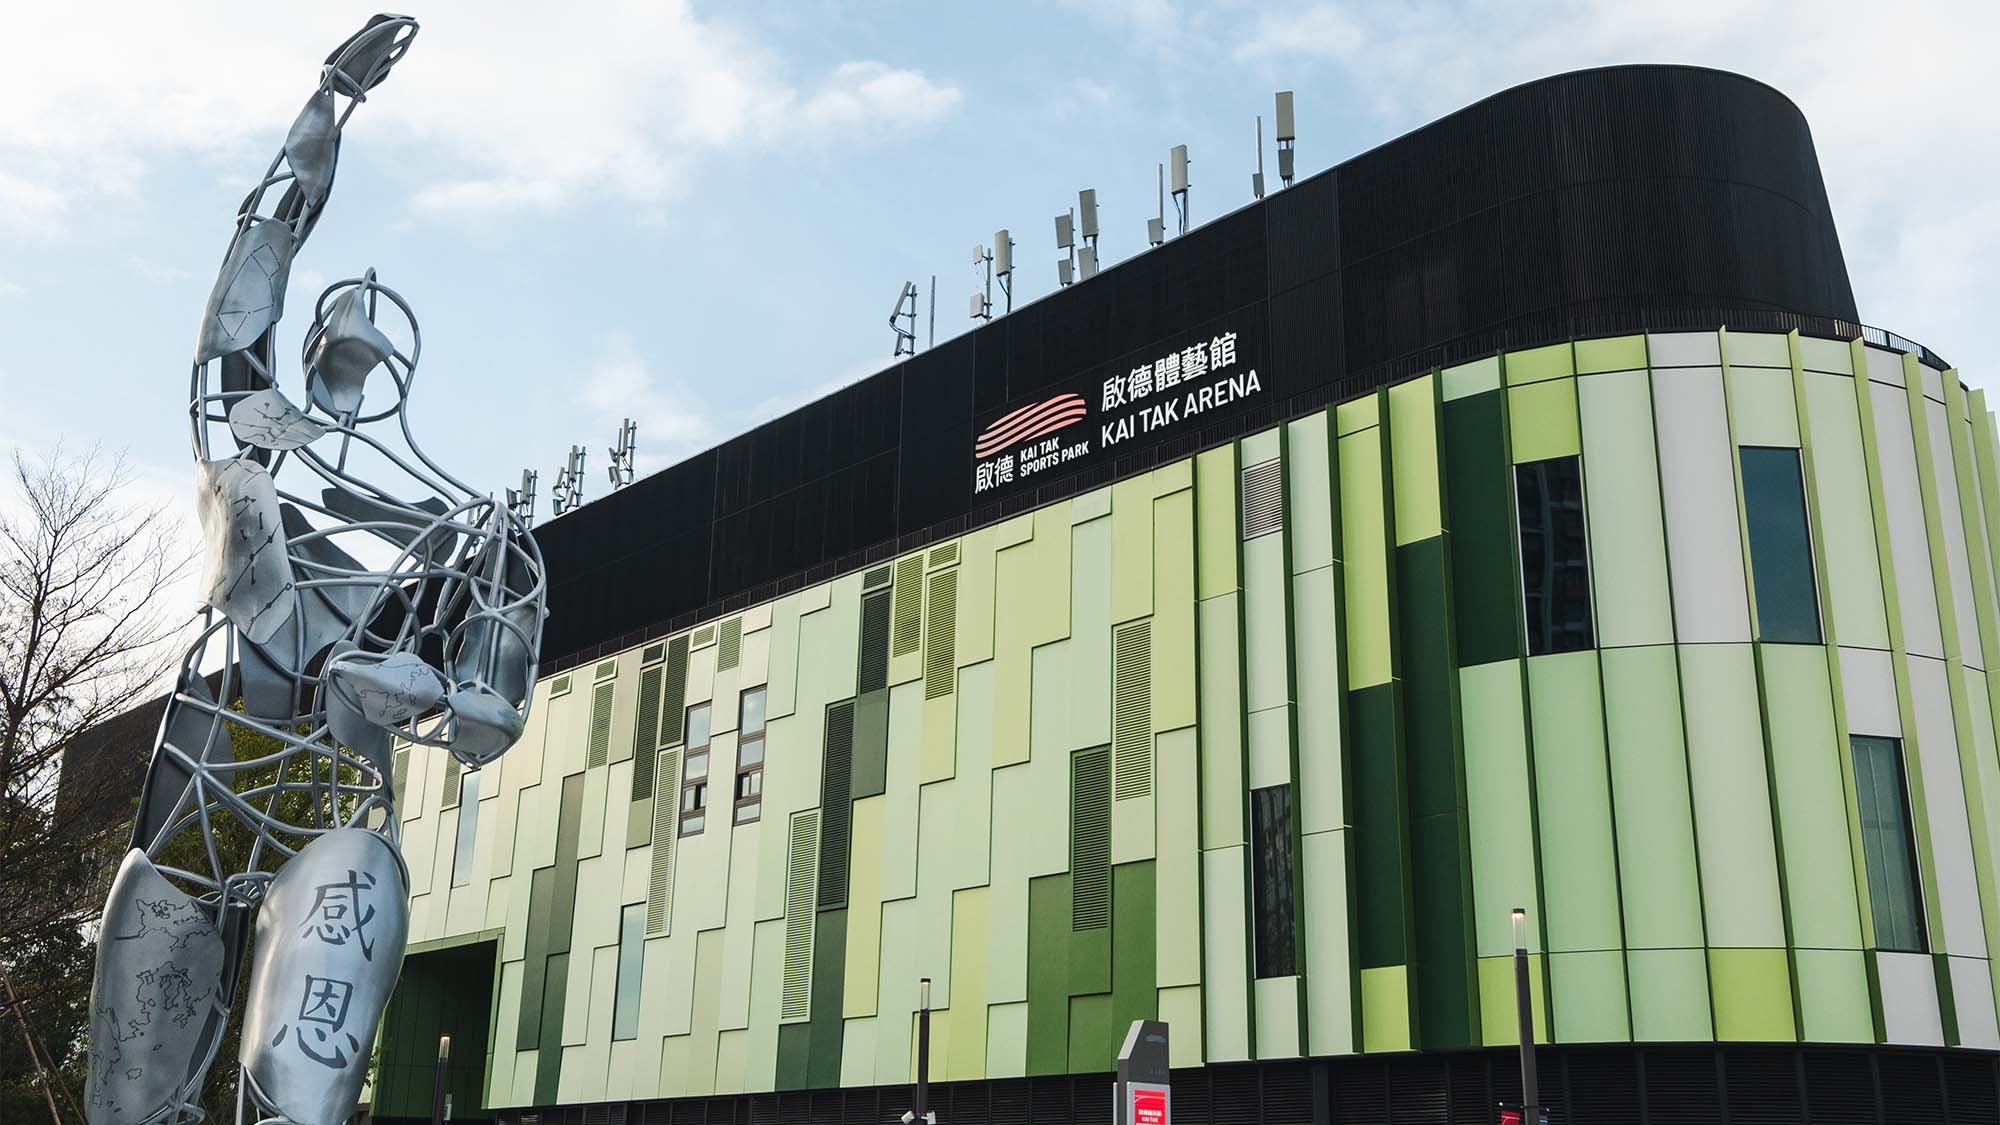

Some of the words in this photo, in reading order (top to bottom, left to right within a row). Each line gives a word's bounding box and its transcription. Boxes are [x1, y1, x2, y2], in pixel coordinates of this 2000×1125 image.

[1101, 331, 1237, 412] 啟德體藝館
[1101, 416, 1135, 448] KAI
[1139, 397, 1180, 433] TAK
[1183, 368, 1262, 419] ARENA
[975, 455, 1014, 494] 啟德
[1020, 445, 1037, 461] KAI
[1039, 436, 1060, 456] TAK
[1020, 451, 1060, 477] SPORTS
[1061, 440, 1090, 462] PARK
[272, 869, 376, 1070] 感恩
